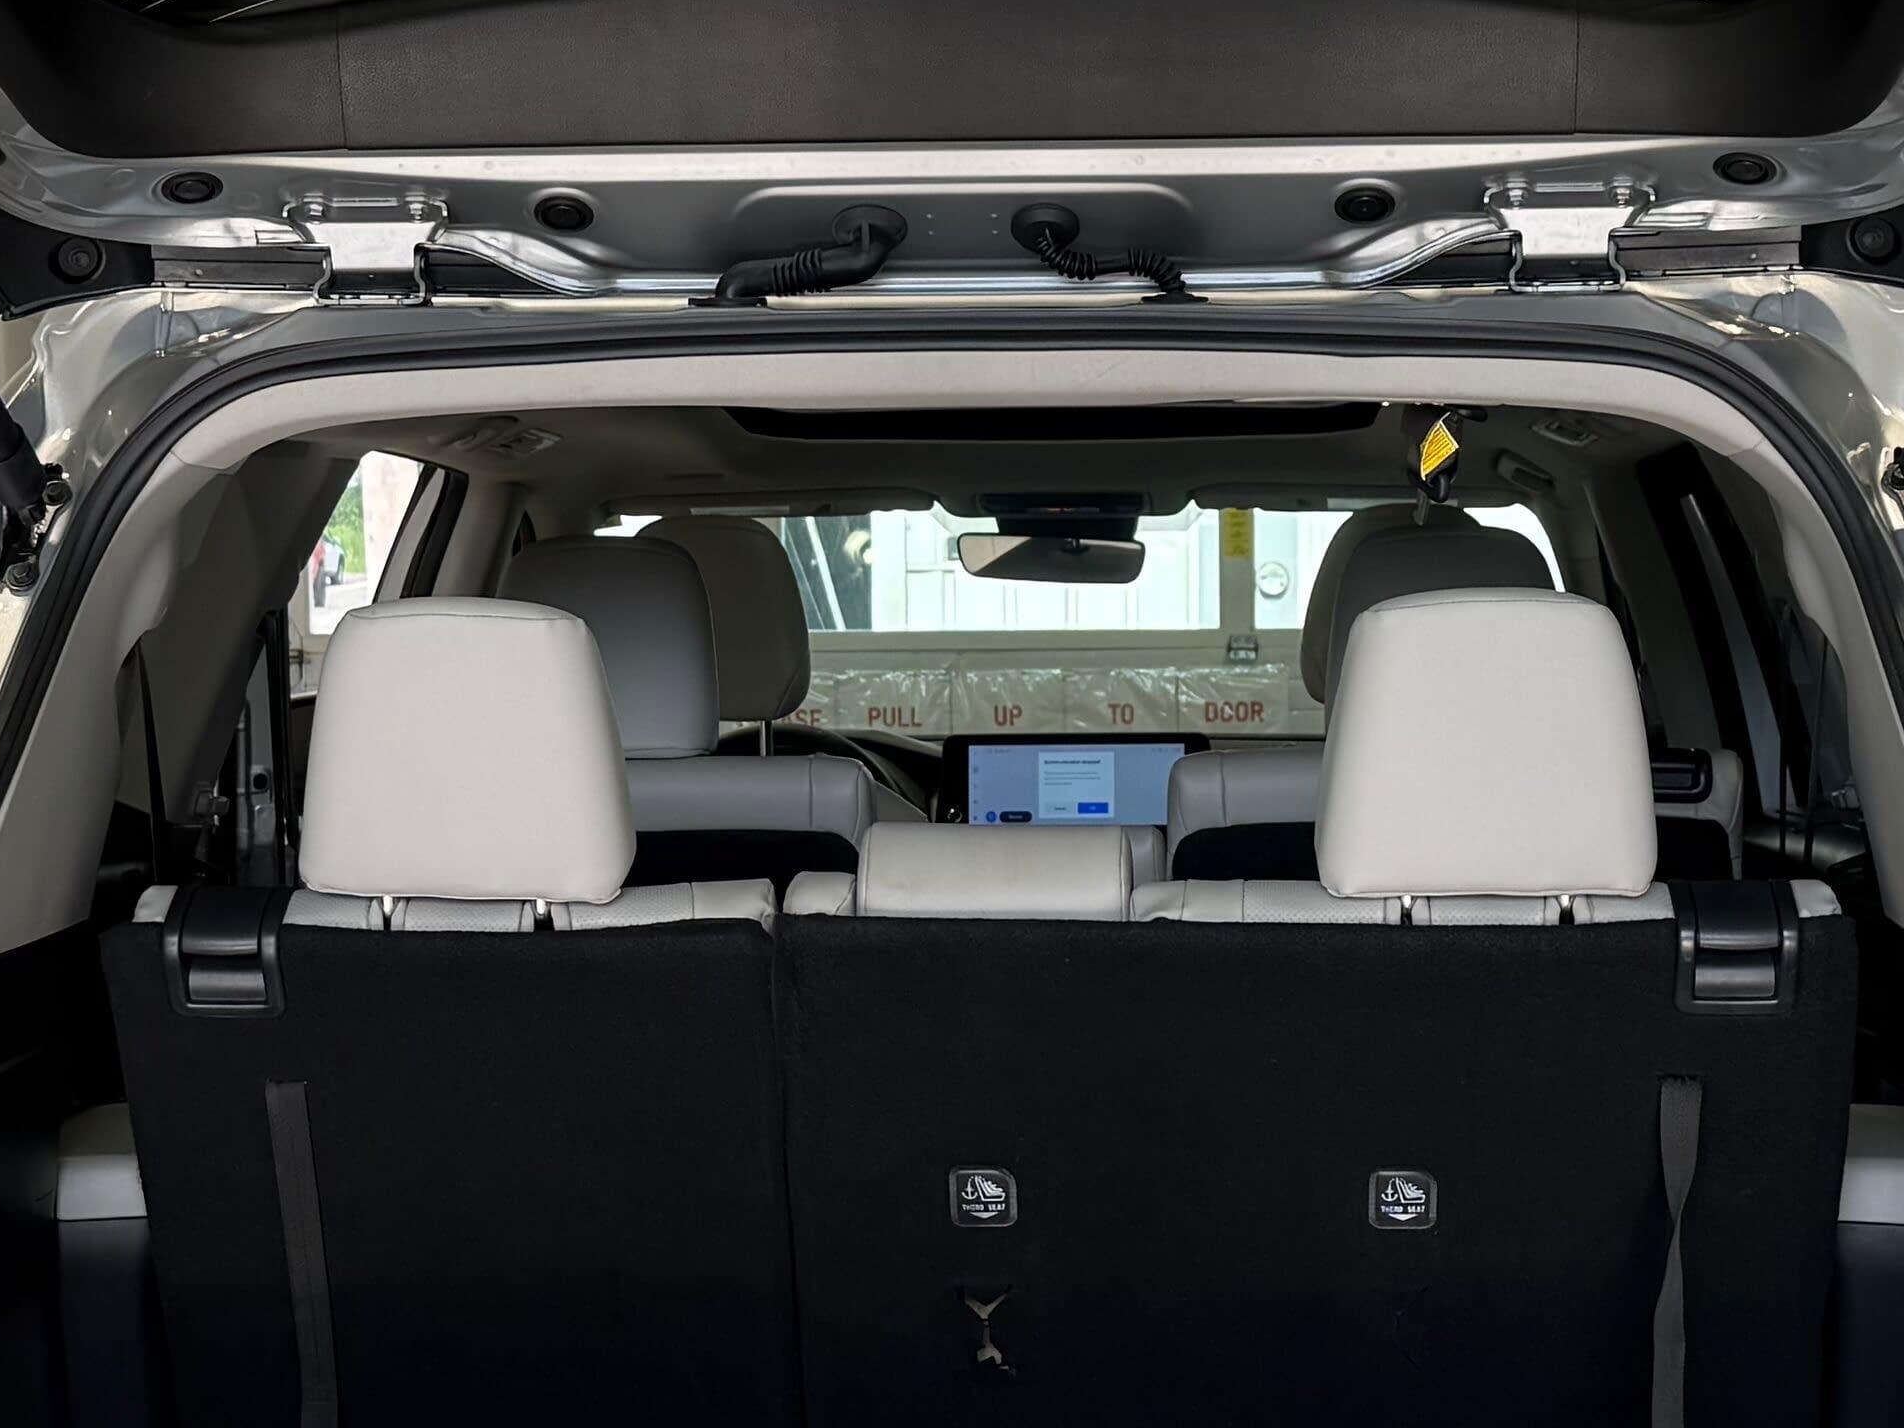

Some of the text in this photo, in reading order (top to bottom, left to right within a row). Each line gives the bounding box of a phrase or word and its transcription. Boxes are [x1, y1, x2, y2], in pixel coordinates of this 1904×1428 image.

[867, 707, 923, 728] PULL
[994, 704, 1023, 727] UP
[1107, 703, 1135, 725] TO
